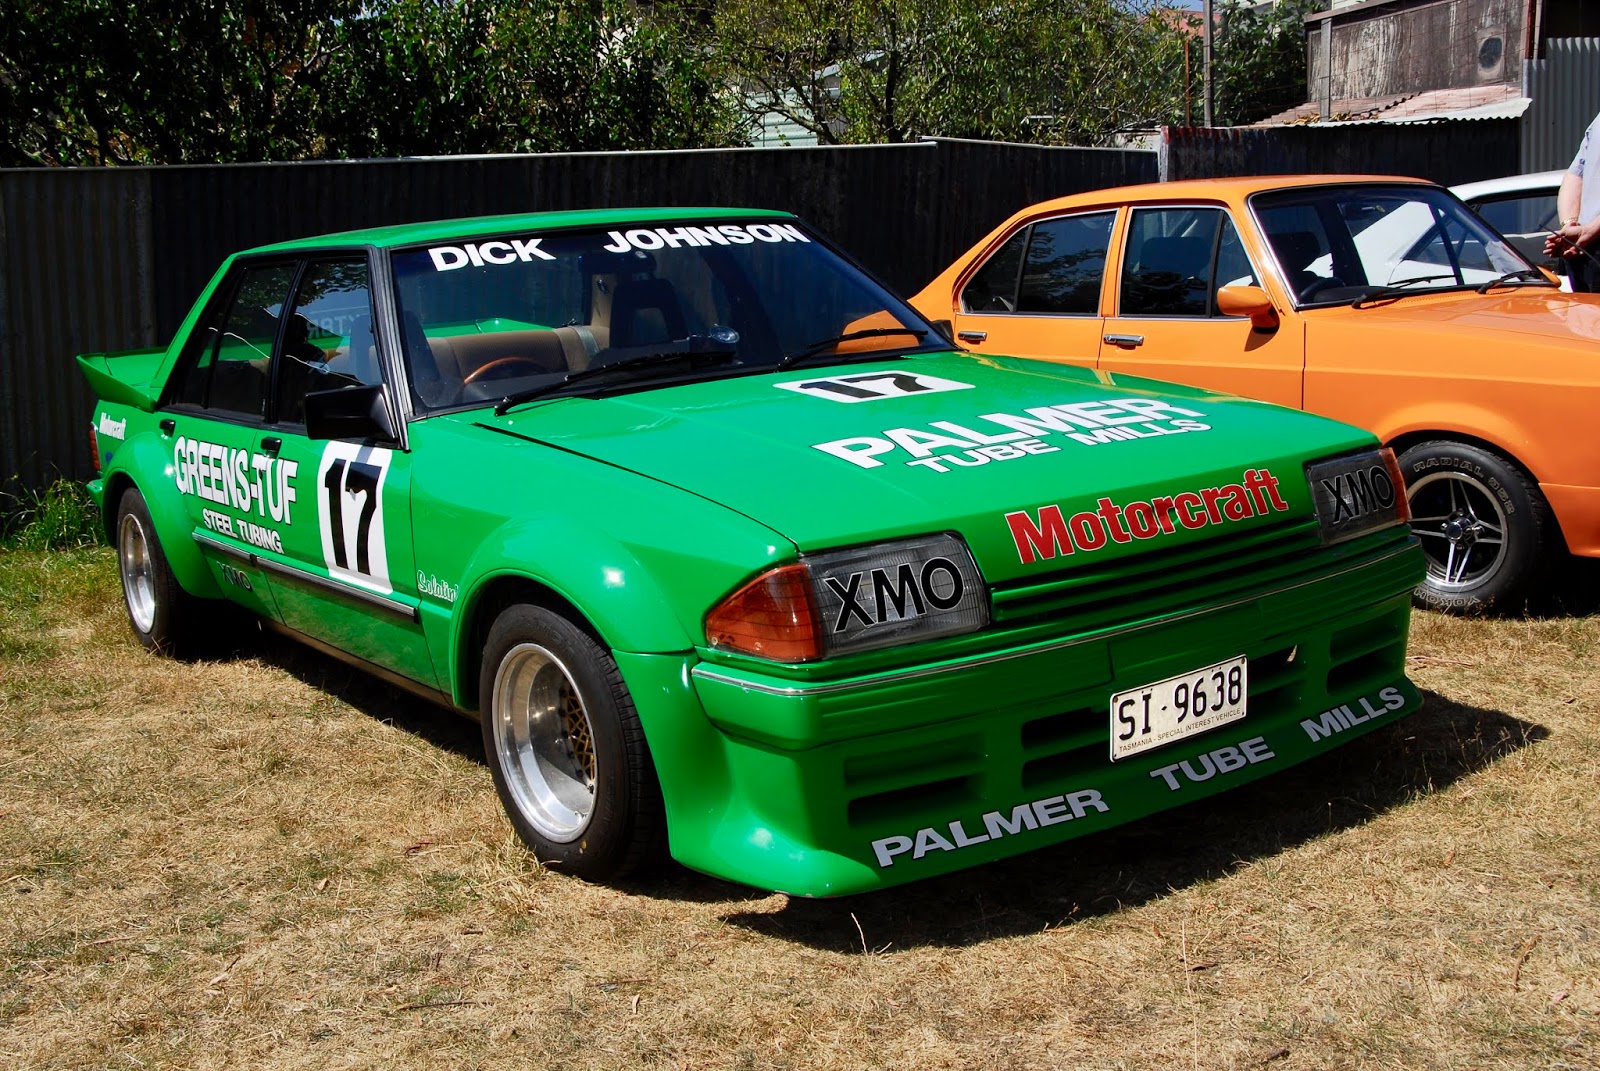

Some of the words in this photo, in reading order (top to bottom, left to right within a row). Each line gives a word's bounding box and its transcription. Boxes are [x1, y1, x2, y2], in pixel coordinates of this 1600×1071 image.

[428, 238, 556, 272] DICK
[603, 224, 811, 254] JOHNSON
[798, 372, 936, 399] 17
[810, 398, 1208, 469] PALMER
[904, 439, 1062, 473] TUBE
[1063, 419, 1212, 447] MILLS
[174, 436, 299, 525] GREENS-TUF
[1321, 465, 1395, 525] XMO
[1413, 457, 1484, 479] RADIAL
[202, 508, 239, 538] STEEL
[236, 519, 285, 554] TUBING
[324, 458, 383, 577] 17
[1004, 468, 1289, 564] Motorcraft
[824, 556, 965, 634] XMO
[1119, 738, 1153, 753] TASMANIA
[1157, 728, 1184, 741] SPECIAL
[1185, 716, 1215, 731] INTEREST
[1216, 707, 1241, 722] VEHICLE
[869, 788, 1111, 868] PALMER
[1149, 736, 1276, 791] TUBE
[1299, 686, 1406, 743] MILLS
